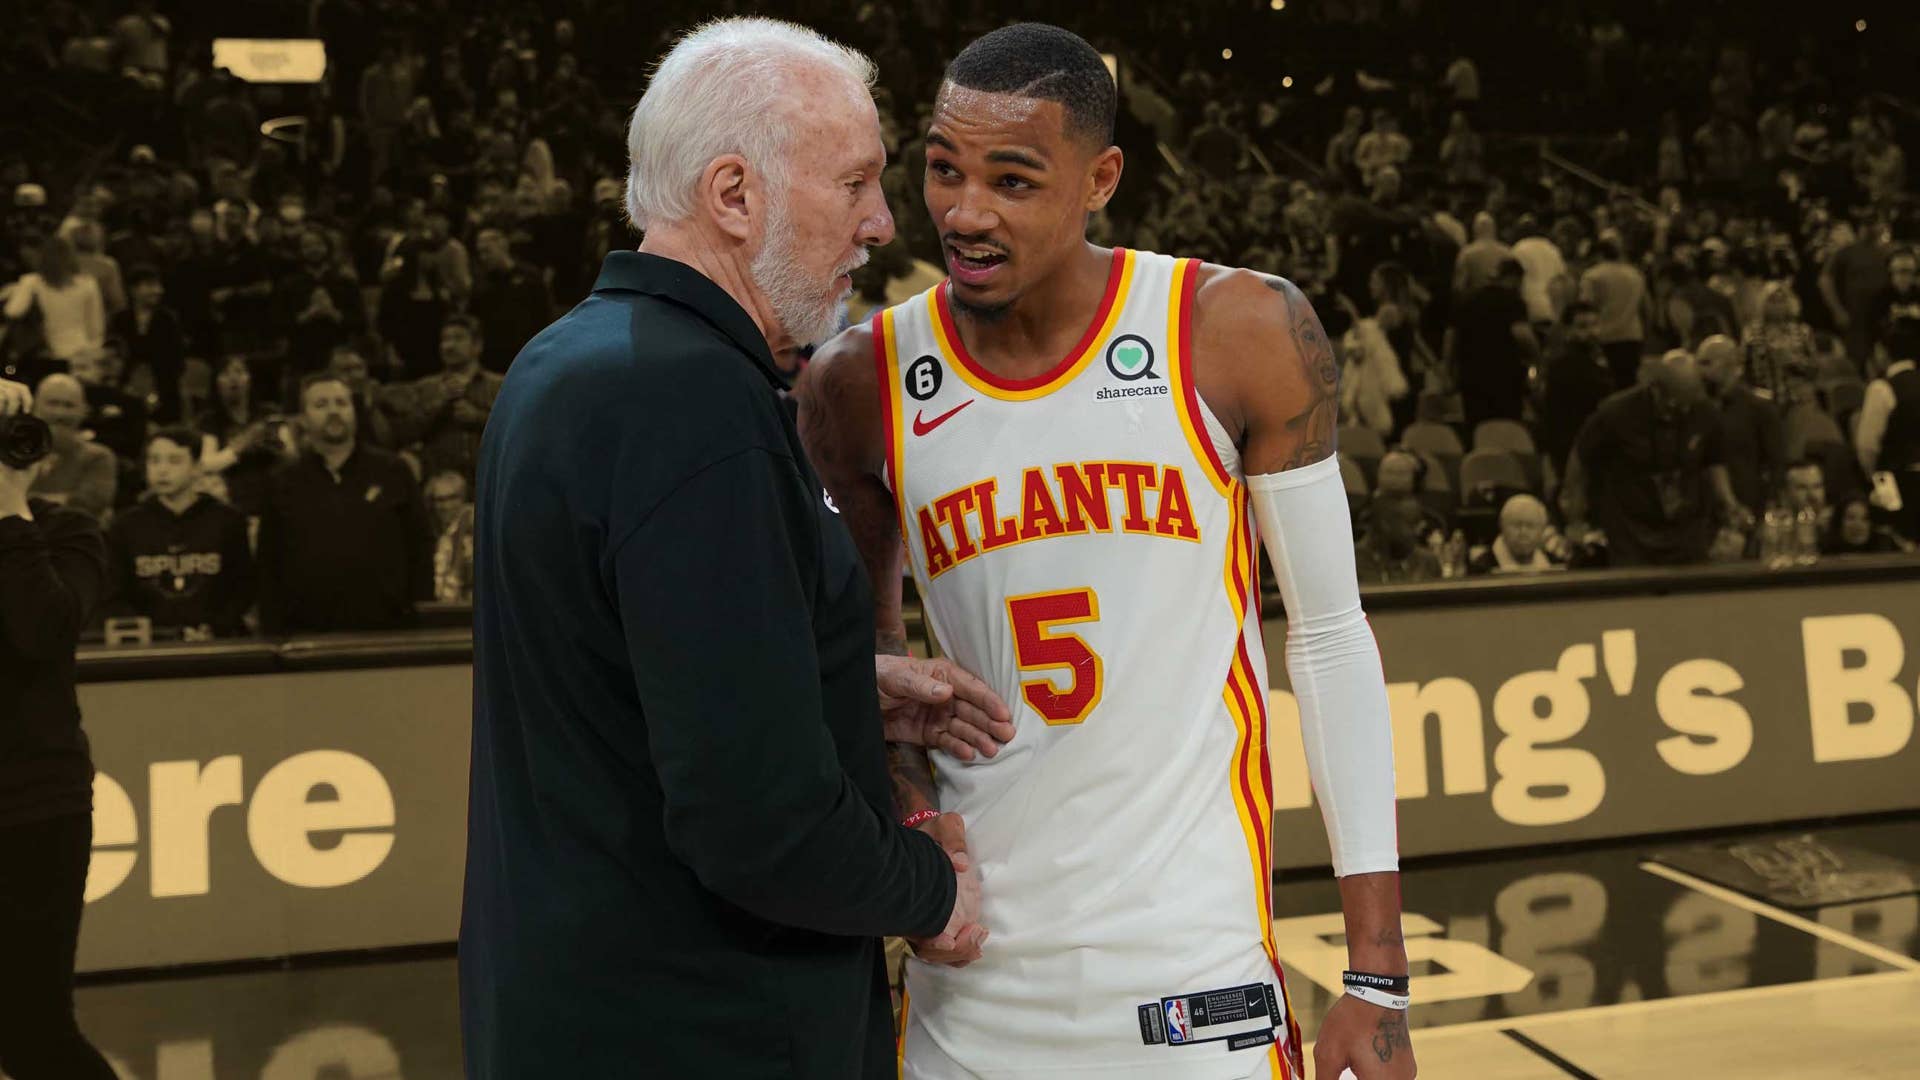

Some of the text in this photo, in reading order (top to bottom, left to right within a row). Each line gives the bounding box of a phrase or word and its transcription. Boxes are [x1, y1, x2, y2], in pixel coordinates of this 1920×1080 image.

[916, 362, 934, 396] 6
[1095, 382, 1168, 400] sharecare
[916, 462, 1201, 579] ATLANTA
[135, 552, 221, 577] SPURS
[1005, 586, 1104, 726] 5
[1802, 613, 1920, 763] B
[1193, 1008, 1205, 1017] 46
